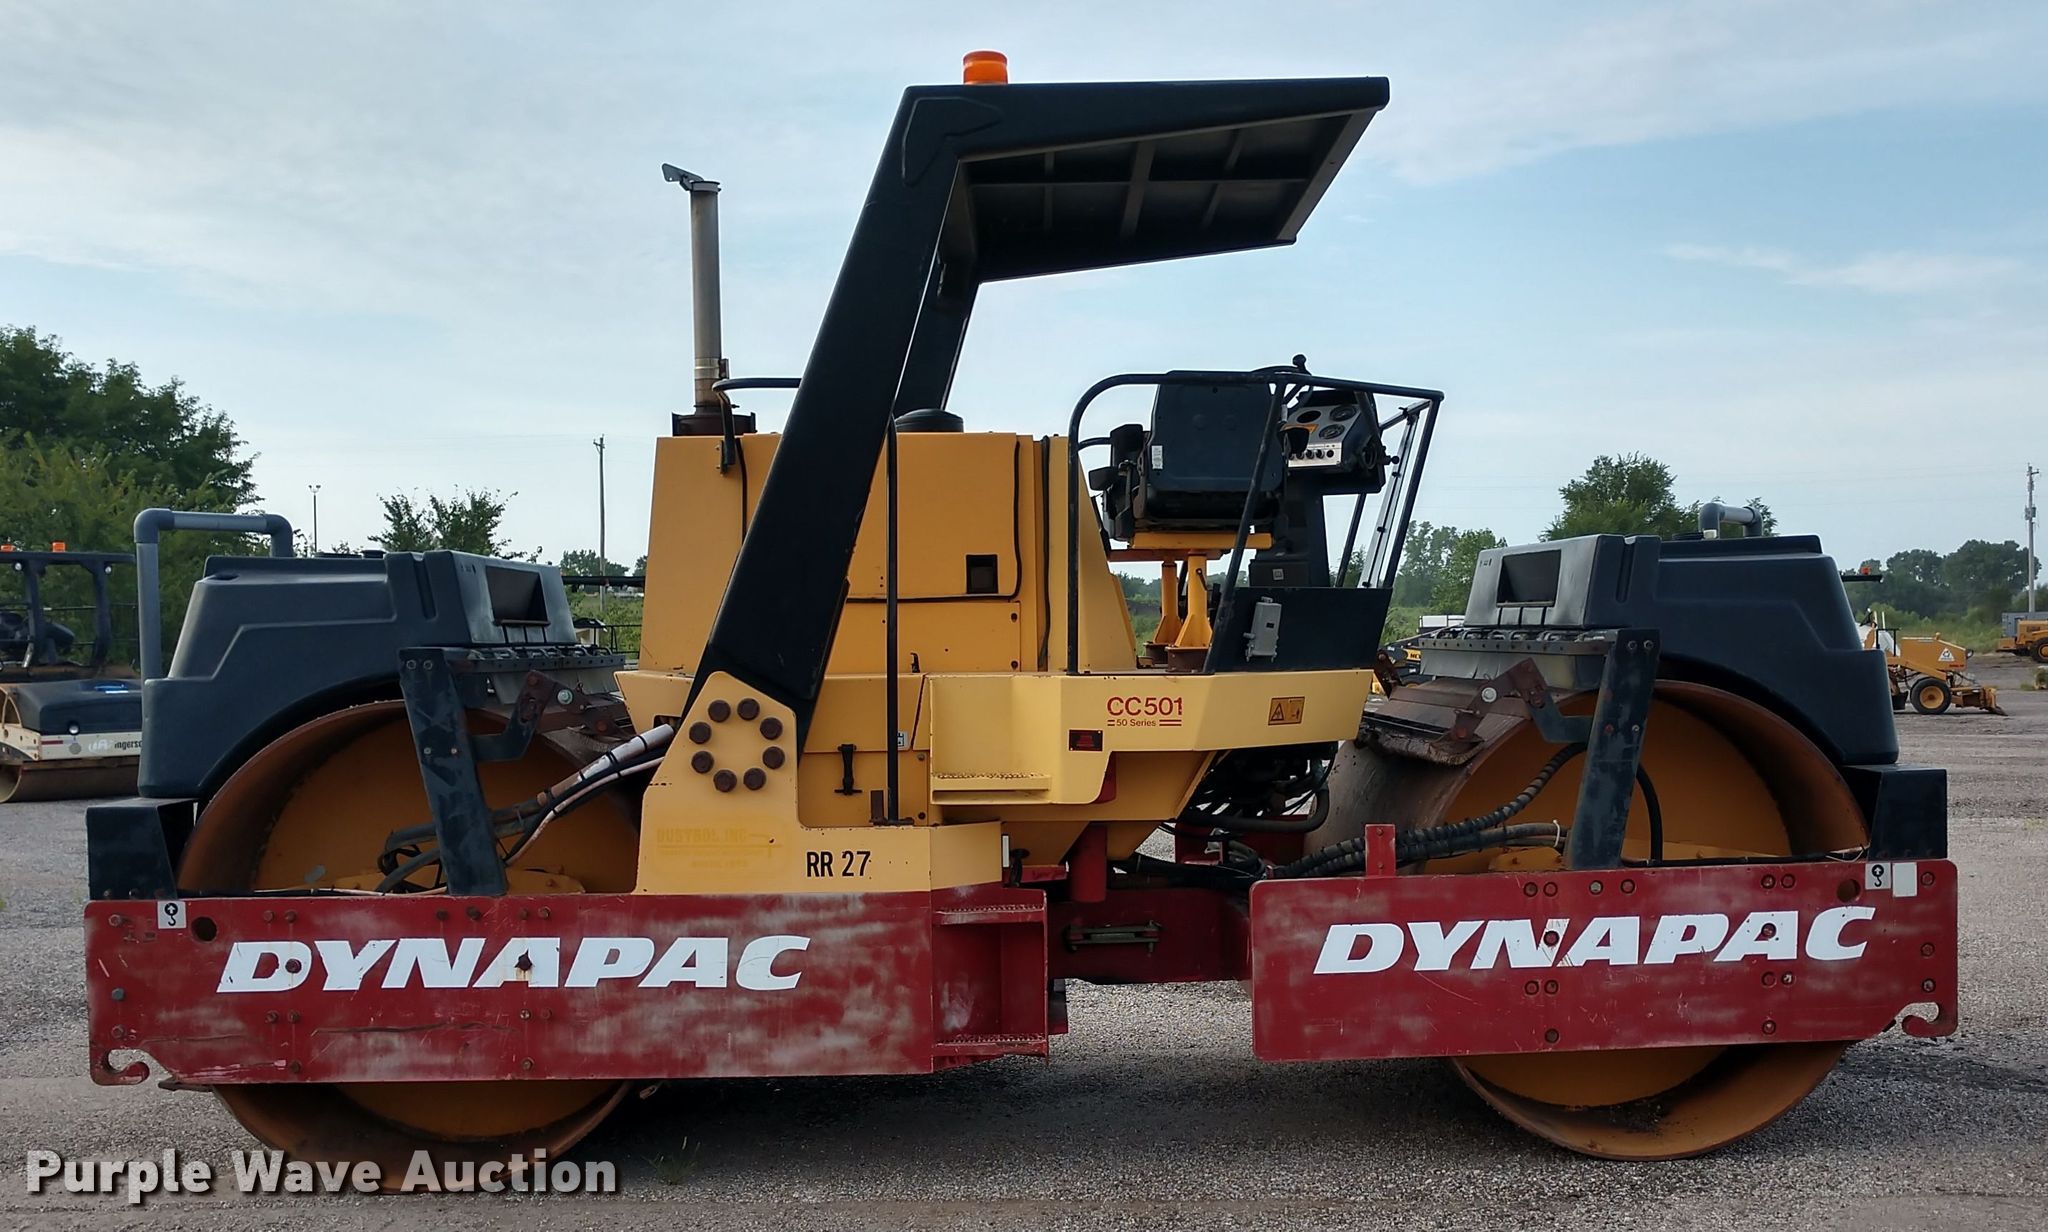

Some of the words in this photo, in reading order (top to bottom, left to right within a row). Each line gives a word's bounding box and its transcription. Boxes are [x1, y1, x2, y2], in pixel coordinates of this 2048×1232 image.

[1106, 696, 1183, 716] CC501
[1116, 719, 1128, 727] 50
[1129, 718, 1157, 727] Series
[806, 850, 834, 878] RR
[841, 850, 871, 877] 27
[1312, 906, 1877, 975] DYNAPAC
[215, 936, 811, 994] DYNAPAC
